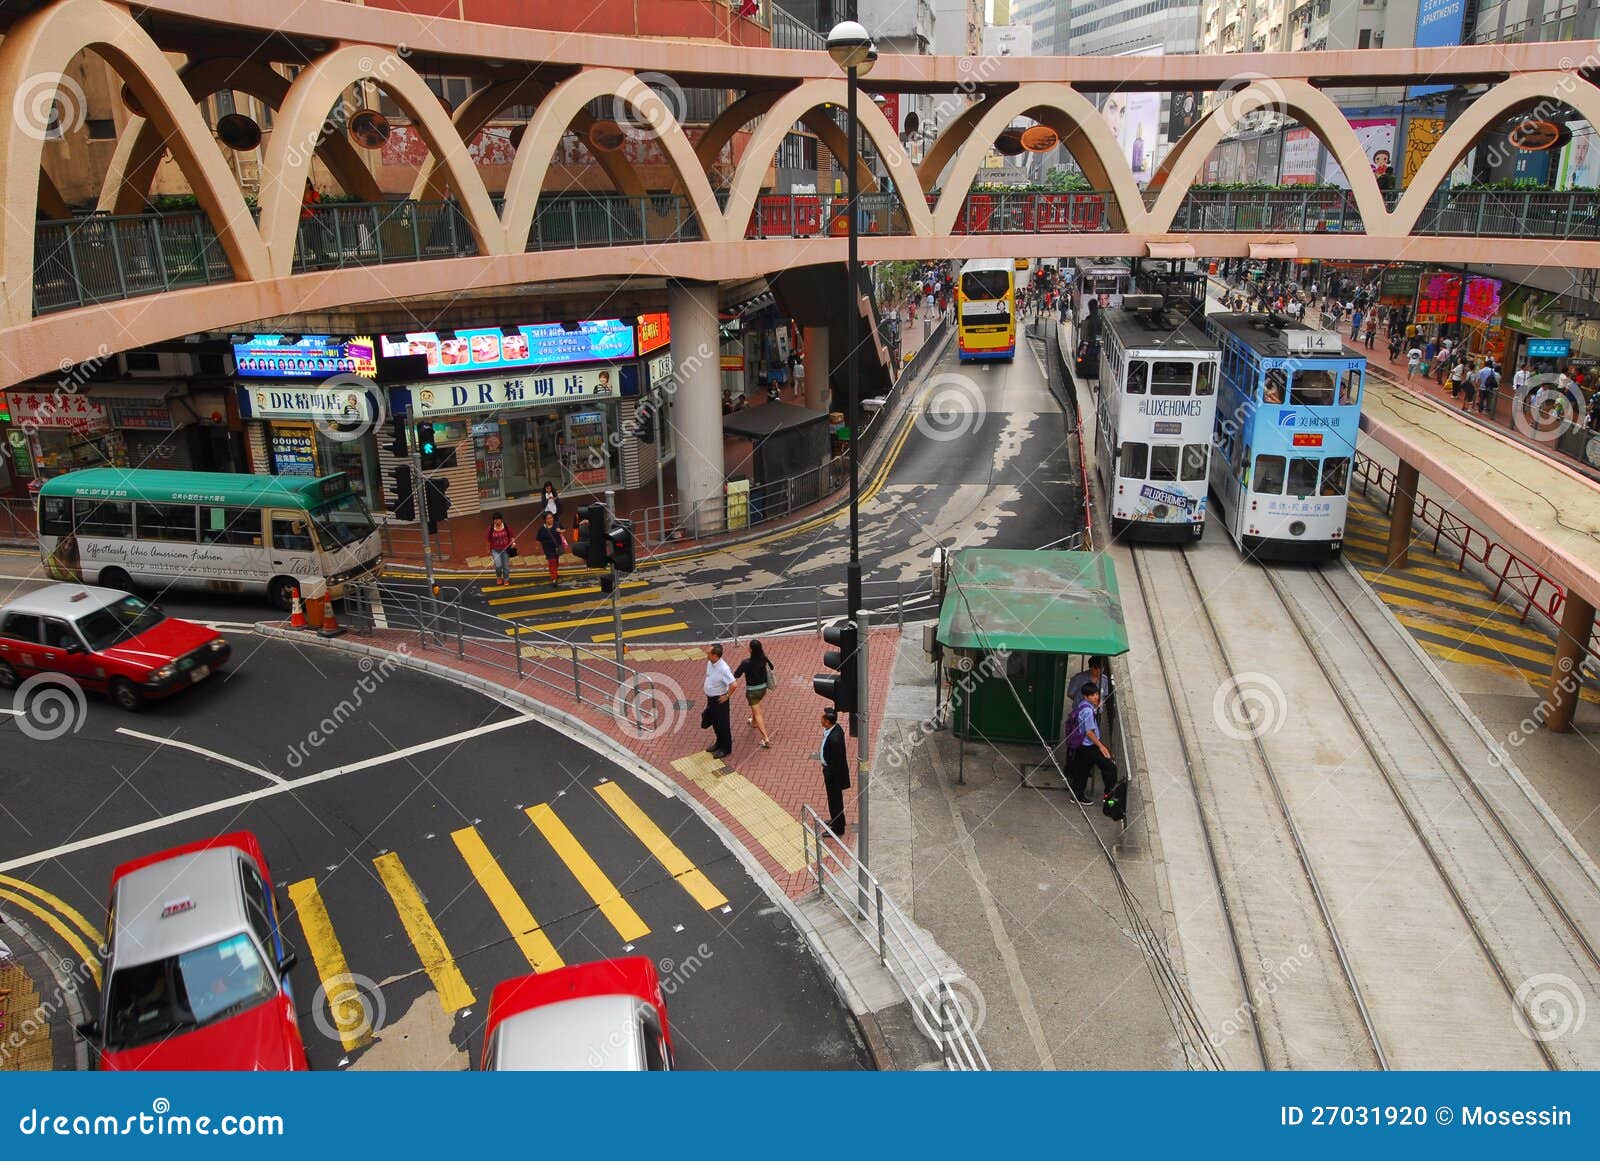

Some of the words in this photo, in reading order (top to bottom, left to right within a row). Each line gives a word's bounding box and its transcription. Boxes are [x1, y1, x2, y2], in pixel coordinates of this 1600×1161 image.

[1306, 335, 1326, 348] 114
[1146, 399, 1202, 417] LUXEHOMES
[1148, 487, 1187, 508] LUXEHOMES
[86, 543, 129, 560] Effortlessly
[130, 545, 148, 557] Chic
[150, 546, 189, 559] American
[190, 548, 225, 561] Fashion
